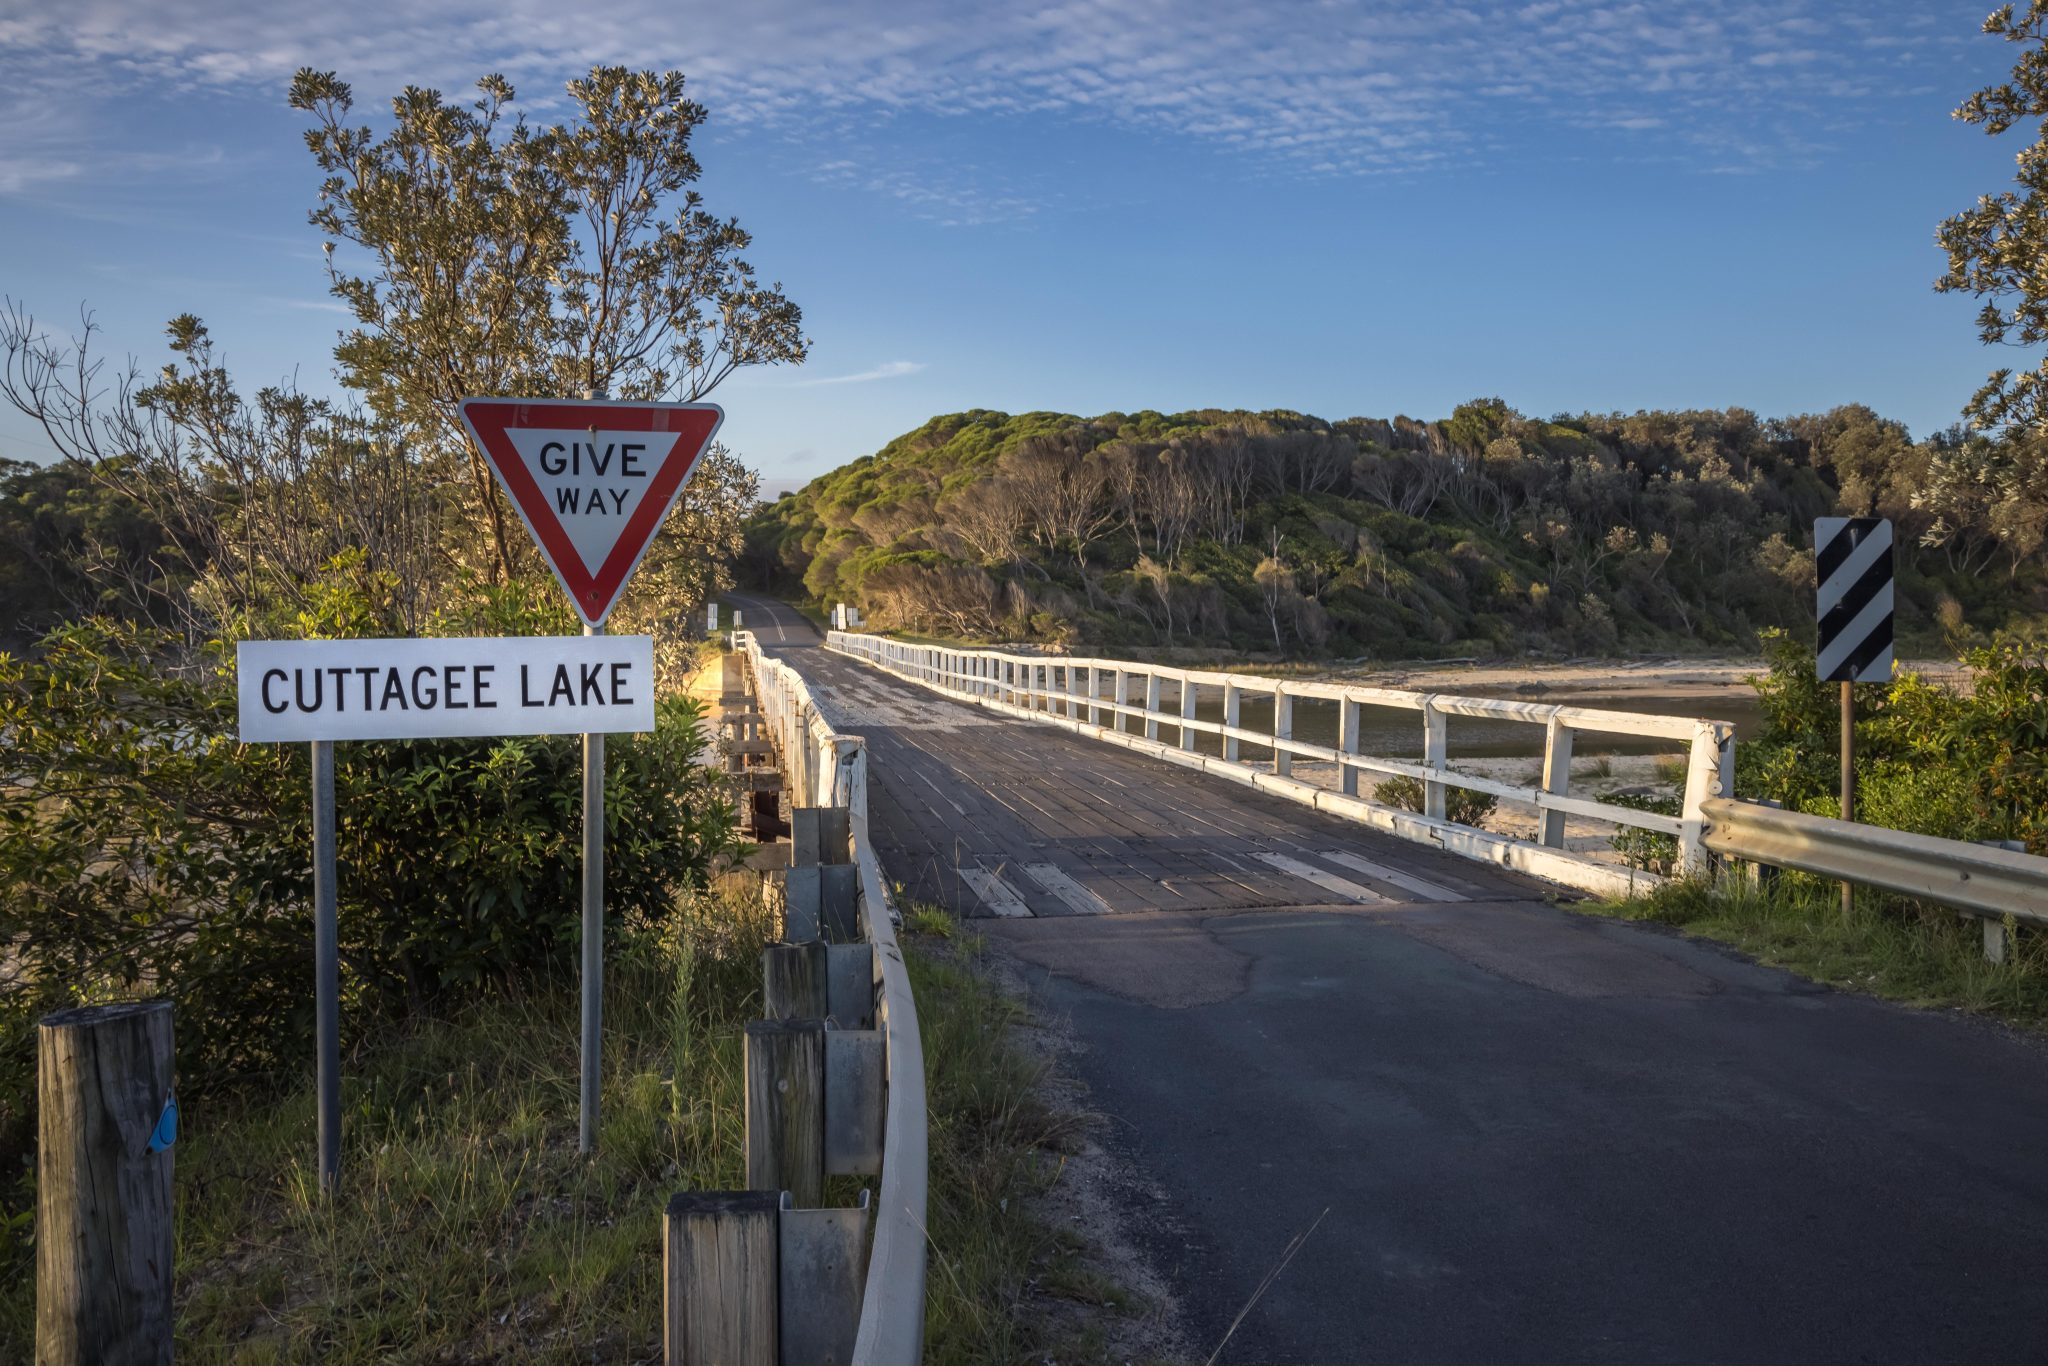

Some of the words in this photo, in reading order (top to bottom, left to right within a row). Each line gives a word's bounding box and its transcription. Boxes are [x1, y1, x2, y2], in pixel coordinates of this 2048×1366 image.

[540, 442, 647, 477] GIVE
[556, 487, 630, 515] WAY
[261, 665, 497, 714] CUTTAGEE
[520, 662, 634, 707] LAKE
